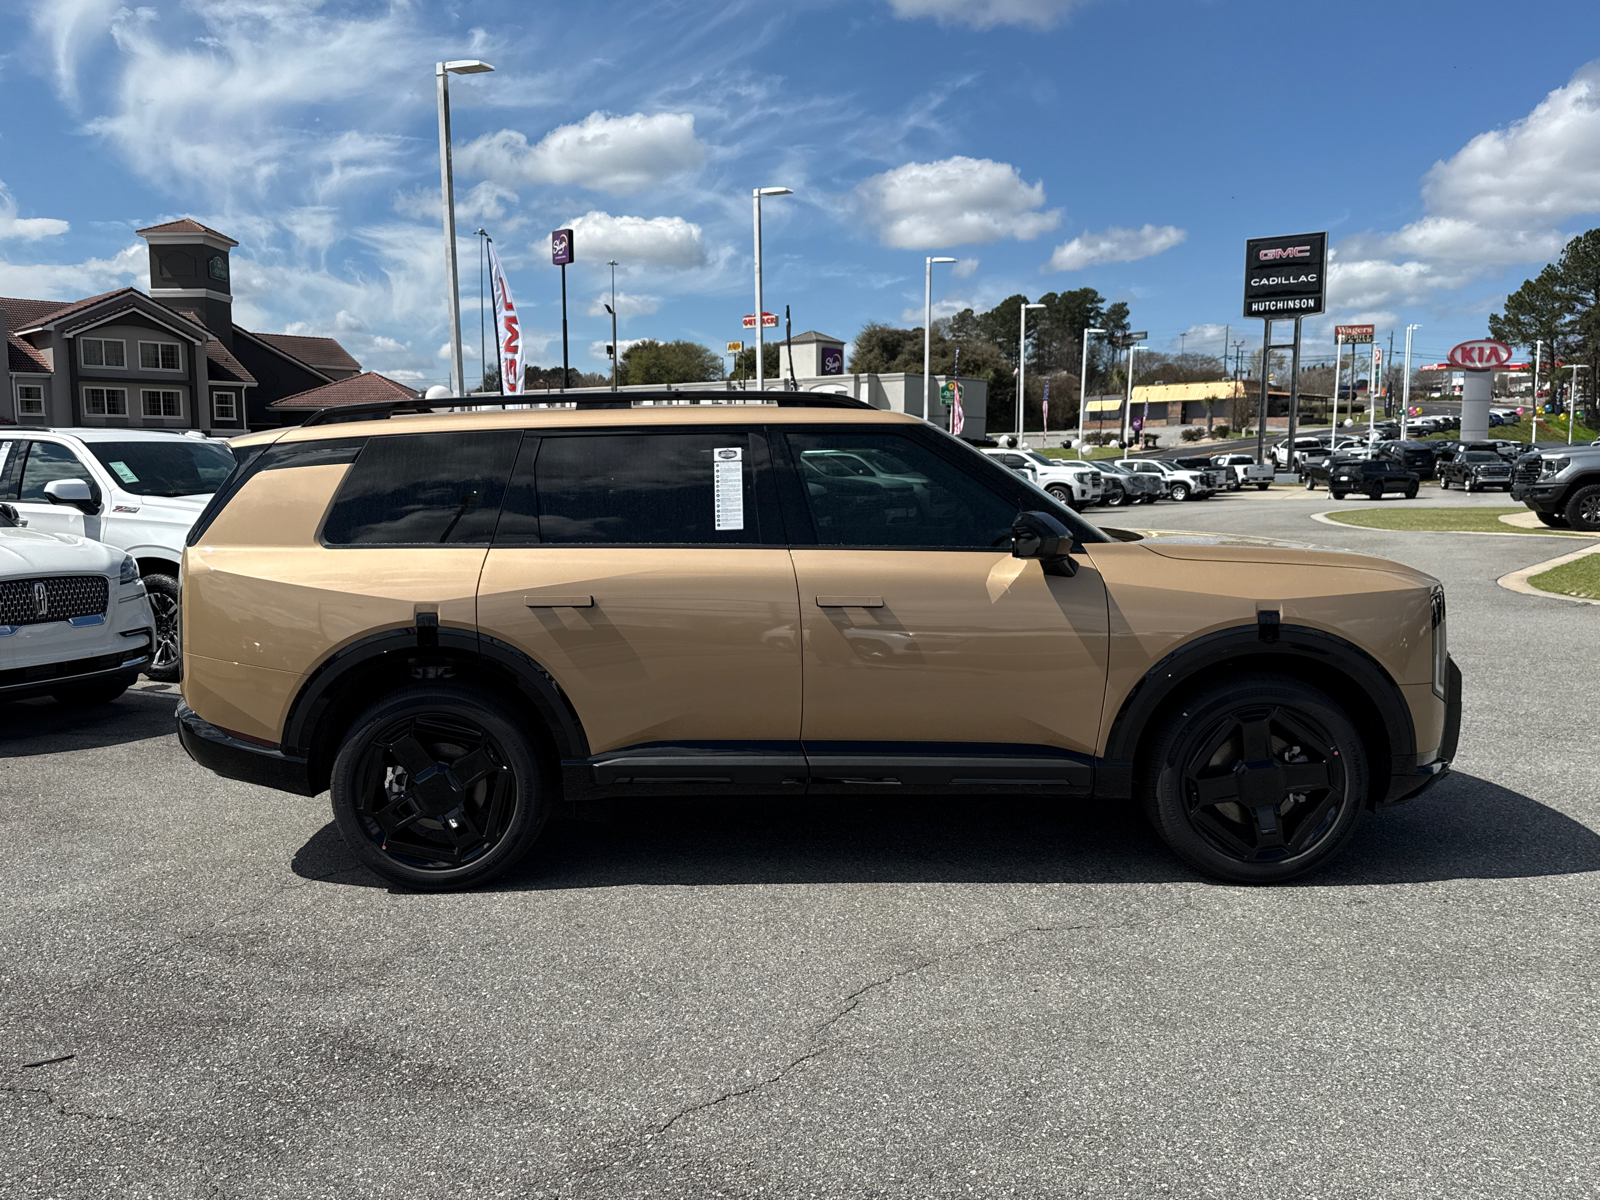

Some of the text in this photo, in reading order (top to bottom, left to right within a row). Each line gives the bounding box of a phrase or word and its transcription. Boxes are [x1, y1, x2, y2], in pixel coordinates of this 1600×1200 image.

[1259, 245, 1311, 261] GMC
[1250, 274, 1317, 286] CADILLAC
[1251, 298, 1315, 312] HUTCHINSON
[743, 317, 776, 326] OUTACK
[1337, 326, 1373, 335] Wagers
[1460, 346, 1502, 363] KIA
[1347, 740, 1363, 786] KUMHO
[521, 777, 532, 822] KUMHO
[1164, 781, 1181, 827] KUMHO
